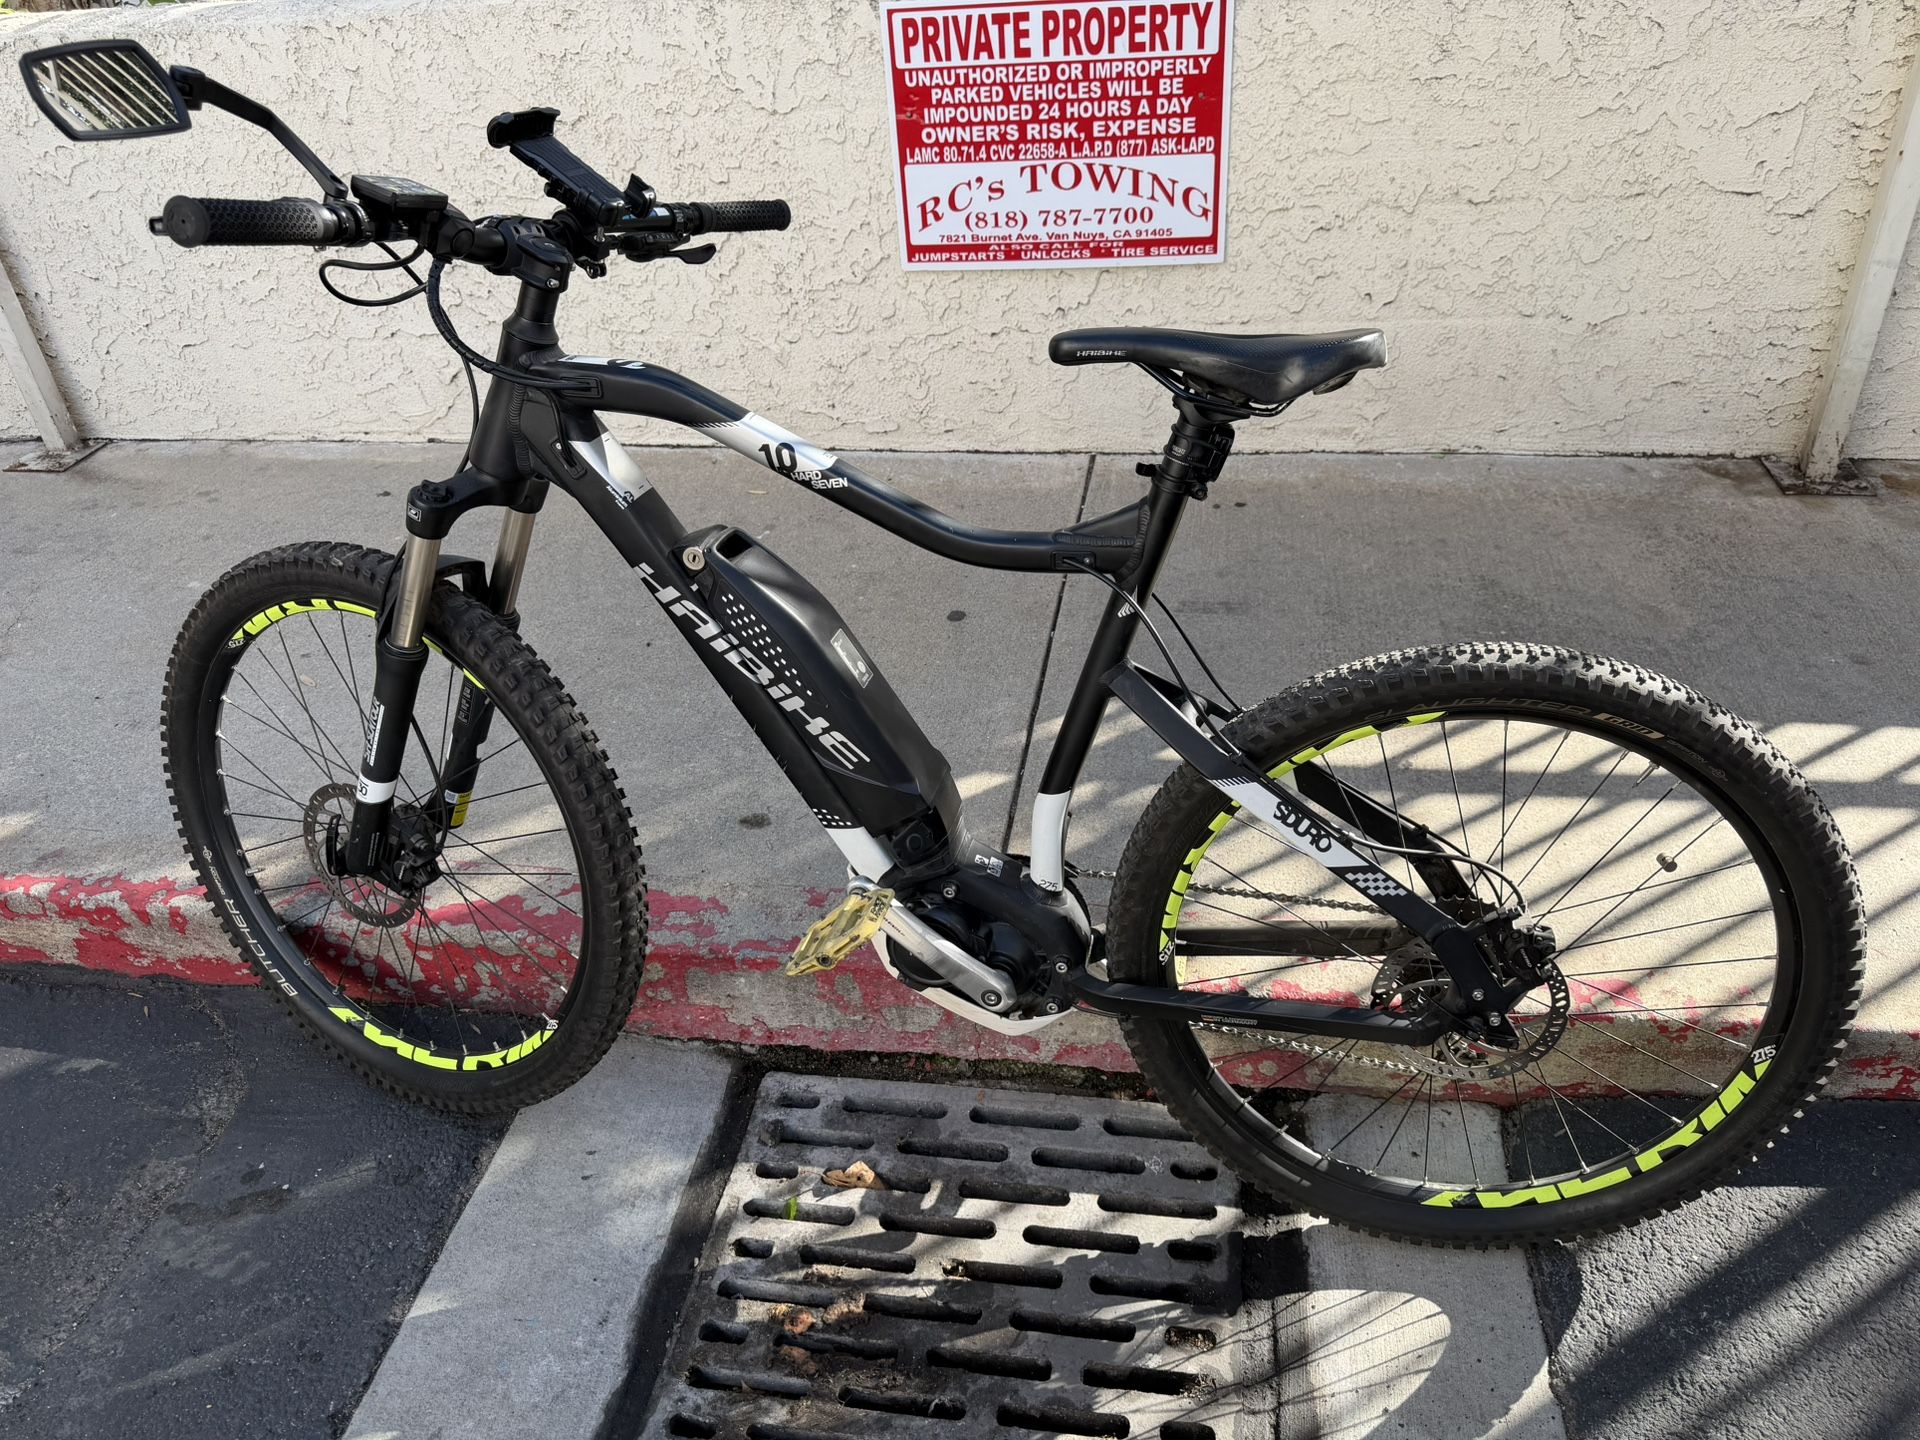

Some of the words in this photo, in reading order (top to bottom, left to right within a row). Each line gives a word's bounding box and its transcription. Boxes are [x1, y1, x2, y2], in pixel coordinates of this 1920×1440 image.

[901, 12, 1032, 64] PRIVATE
[1042, 1, 1214, 57] PROPERTY
[904, 65, 1051, 87] UNAUTHORIZED
[1056, 63, 1083, 81] OR
[1089, 57, 1212, 79] IMPROPERLY
[931, 86, 1004, 105] PARKED
[1009, 82, 1101, 102] VEHICLES
[1107, 79, 1153, 98] WILL
[1159, 78, 1184, 95] BE
[923, 104, 1033, 124] IMPOUNDED
[1038, 103, 1060, 120] 24
[1066, 99, 1132, 119] HOURS
[1137, 98, 1151, 116] A
[1156, 96, 1194, 115] DAY
[921, 124, 1019, 144] OWNER'S
[1026, 121, 1085, 142] RISK,
[1092, 117, 1196, 138] EXPENSE
[906, 147, 940, 164] LAMC
[943, 145, 987, 163] 80.71.4
[990, 144, 1015, 161] CVC
[1019, 142, 1067, 160] 22658-A
[1116, 138, 1147, 158] (877)
[1151, 136, 1215, 155] ASK-LAPD
[1019, 161, 1212, 222] TOWING
[964, 209, 1028, 233] (818)
[1038, 206, 1154, 228] 787-7700
[939, 234, 967, 243] 7821
[971, 233, 1013, 242] Burnet
[1015, 232, 1042, 241] Ave.
[1046, 231, 1069, 241] Van
[1073, 230, 1109, 242] Nuys,
[1112, 229, 1132, 239] CA
[1135, 228, 1173, 238] 91405
[1039, 242, 1084, 250] CALL
[1089, 241, 1124, 249] FOR
[911, 251, 1005, 262] JUMPSTARTS
[1021, 249, 1091, 260] UNLOCKS
[1111, 247, 1145, 257] TIRE
[1150, 244, 1214, 256] SERVICE
[790, 471, 822, 482] HARD
[811, 477, 849, 490] SEVEN
[1273, 800, 1332, 853] SDURO
[223, 898, 299, 997] BUTCHER
